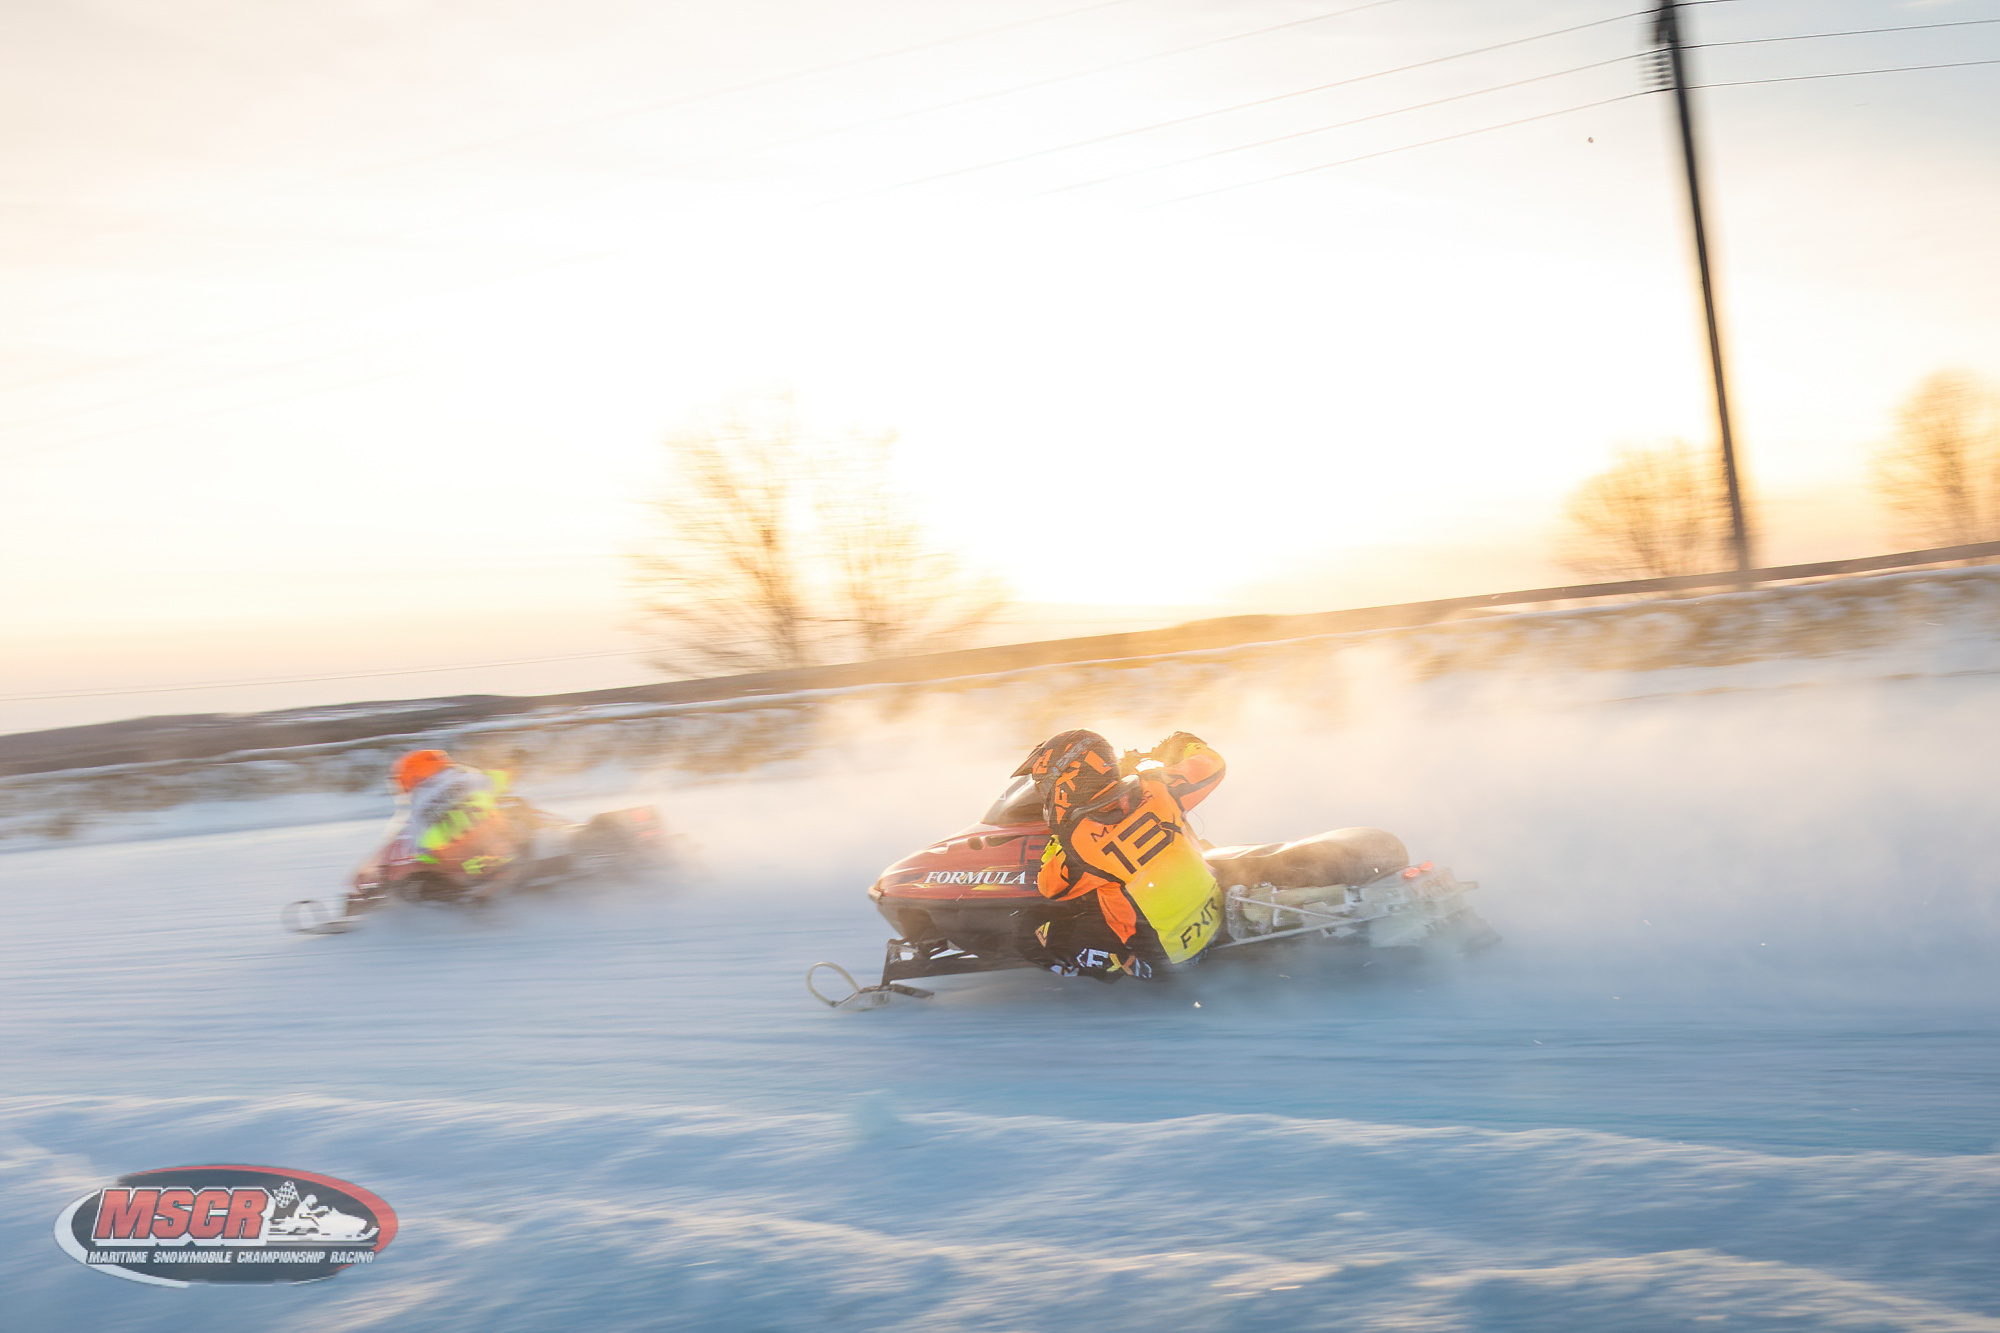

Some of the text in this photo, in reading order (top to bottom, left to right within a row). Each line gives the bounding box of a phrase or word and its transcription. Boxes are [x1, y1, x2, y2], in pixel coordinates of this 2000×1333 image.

[1101, 811, 1175, 875] 13
[923, 870, 1026, 885] FORMULA
[1180, 897, 1219, 950] FXR
